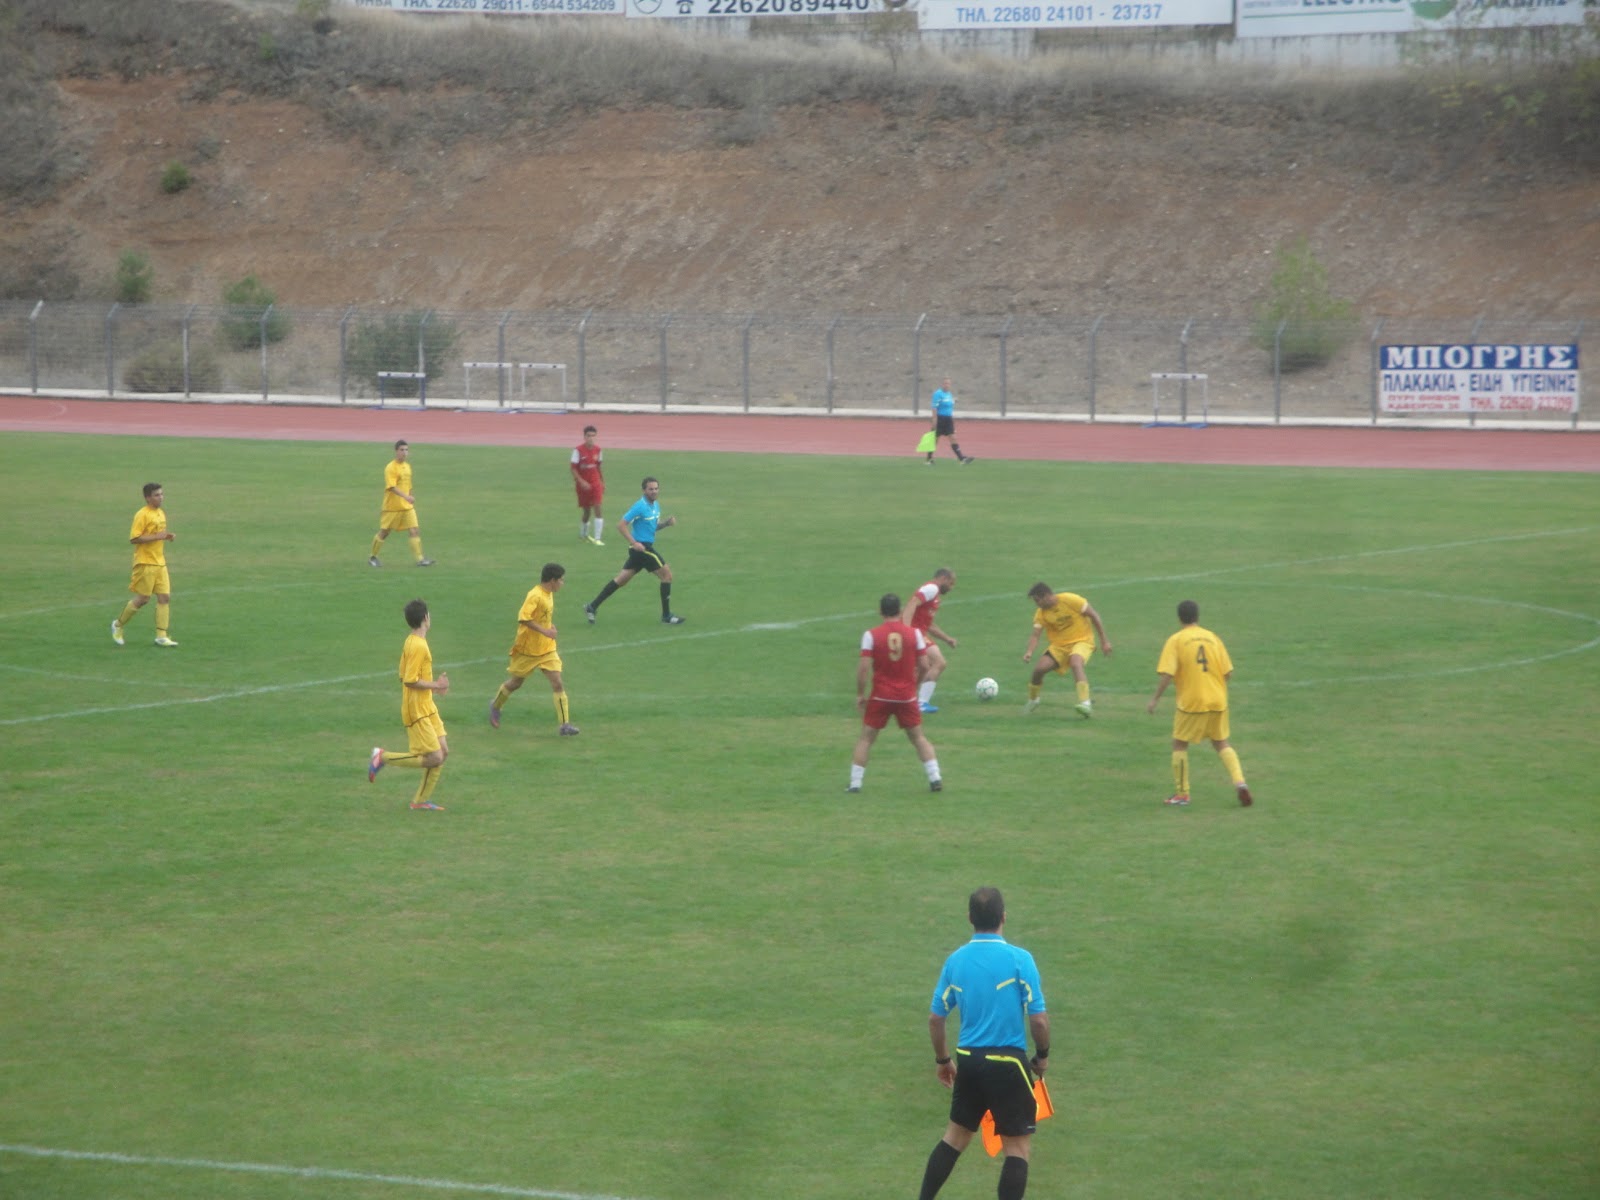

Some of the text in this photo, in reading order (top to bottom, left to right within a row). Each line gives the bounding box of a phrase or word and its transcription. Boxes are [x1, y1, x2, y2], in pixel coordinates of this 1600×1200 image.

[437, 0, 477, 10] 22620
[708, 0, 870, 14] 2262089440
[994, 6, 1041, 22] 22680
[1046, 5, 1093, 21] 24101
[1112, 4, 1162, 20] 23737
[1386, 346, 1573, 369] ΜΠΟΓΡΗΣ
[1384, 374, 1456, 392] ΠΛΑΚΑΚΙΑ
[1469, 374, 1503, 392] ΕΙΔΗ
[887, 632, 903, 661] 9
[1196, 645, 1208, 672] 4
